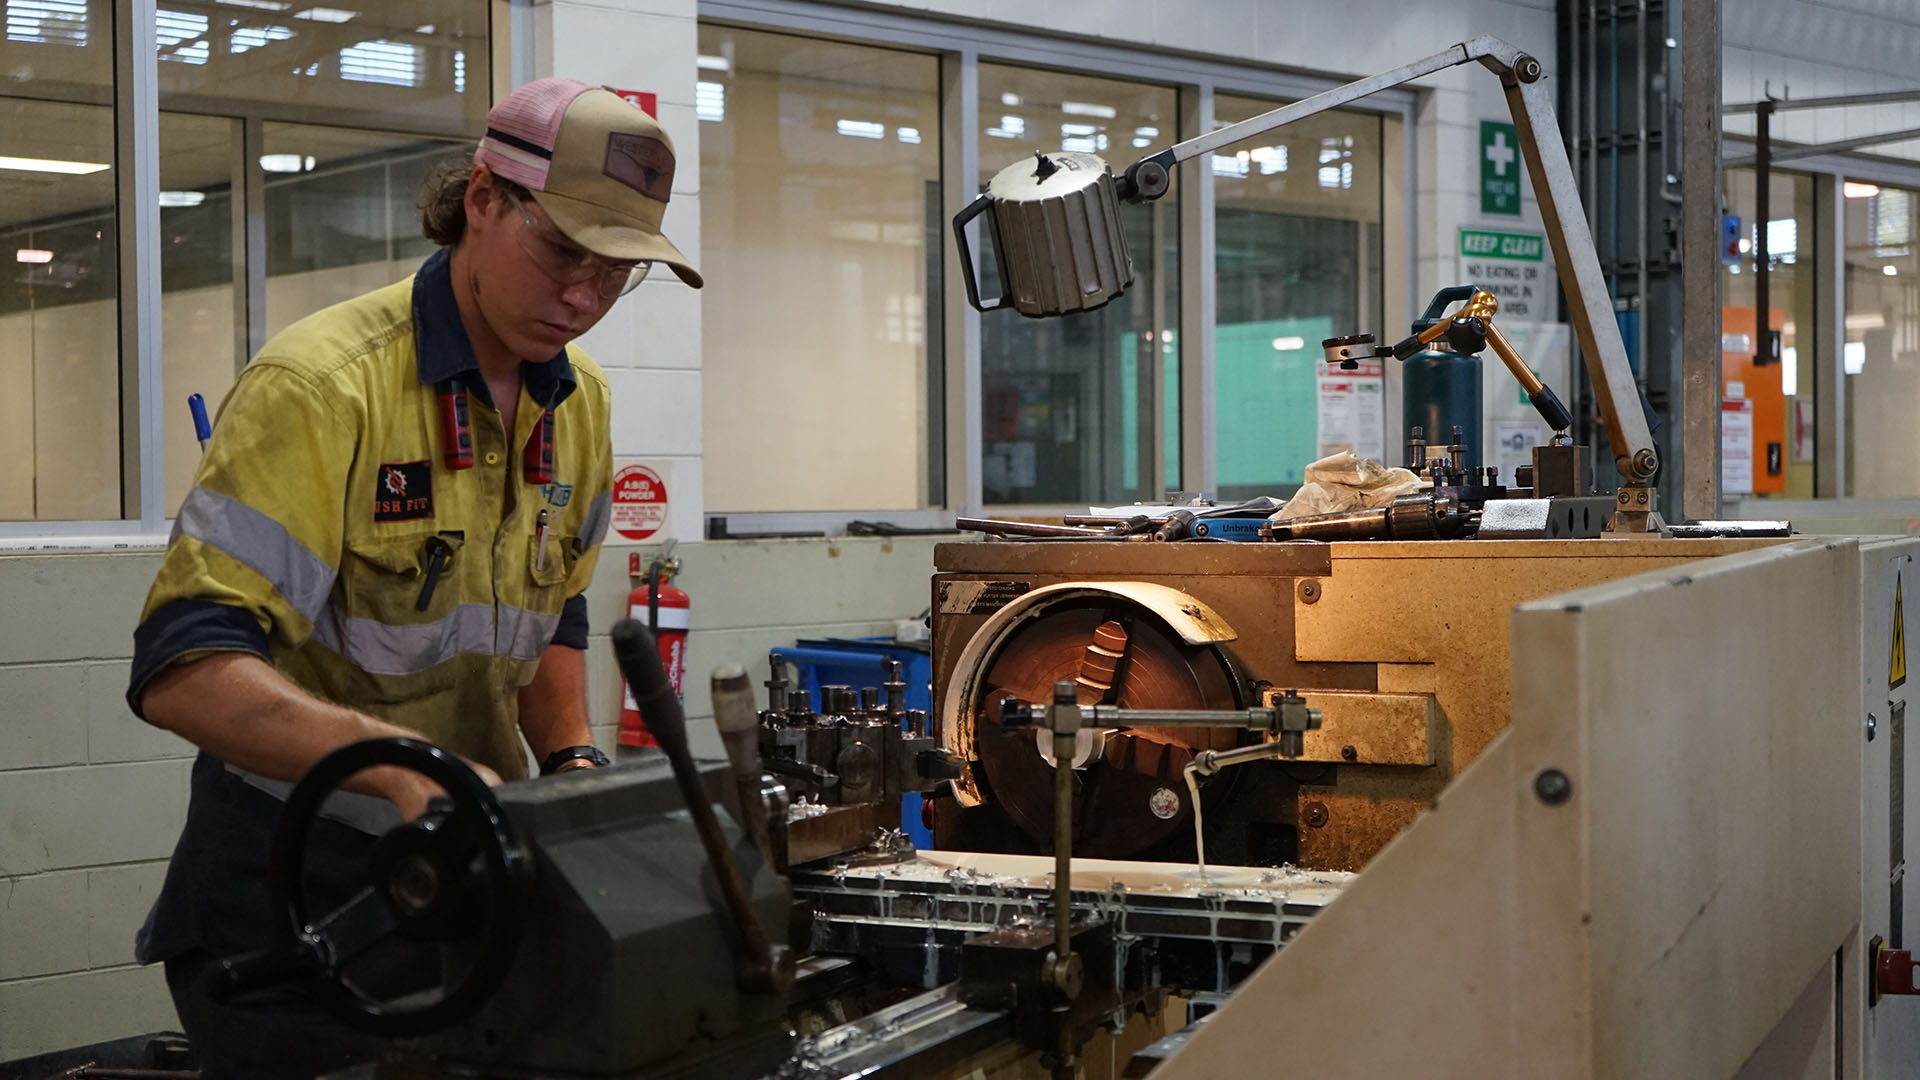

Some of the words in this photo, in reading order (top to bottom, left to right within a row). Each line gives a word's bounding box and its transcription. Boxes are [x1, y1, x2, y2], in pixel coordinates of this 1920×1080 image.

[1464, 234, 1498, 252] KEEP
[1501, 237, 1540, 256] CLEAN
[1467, 264, 1482, 278] NO
[1486, 265, 1520, 280] EATING
[1524, 267, 1538, 281] OR
[407, 497, 428, 511] FIT
[618, 491, 656, 500] POWDER
[669, 640, 680, 681] Chubb
